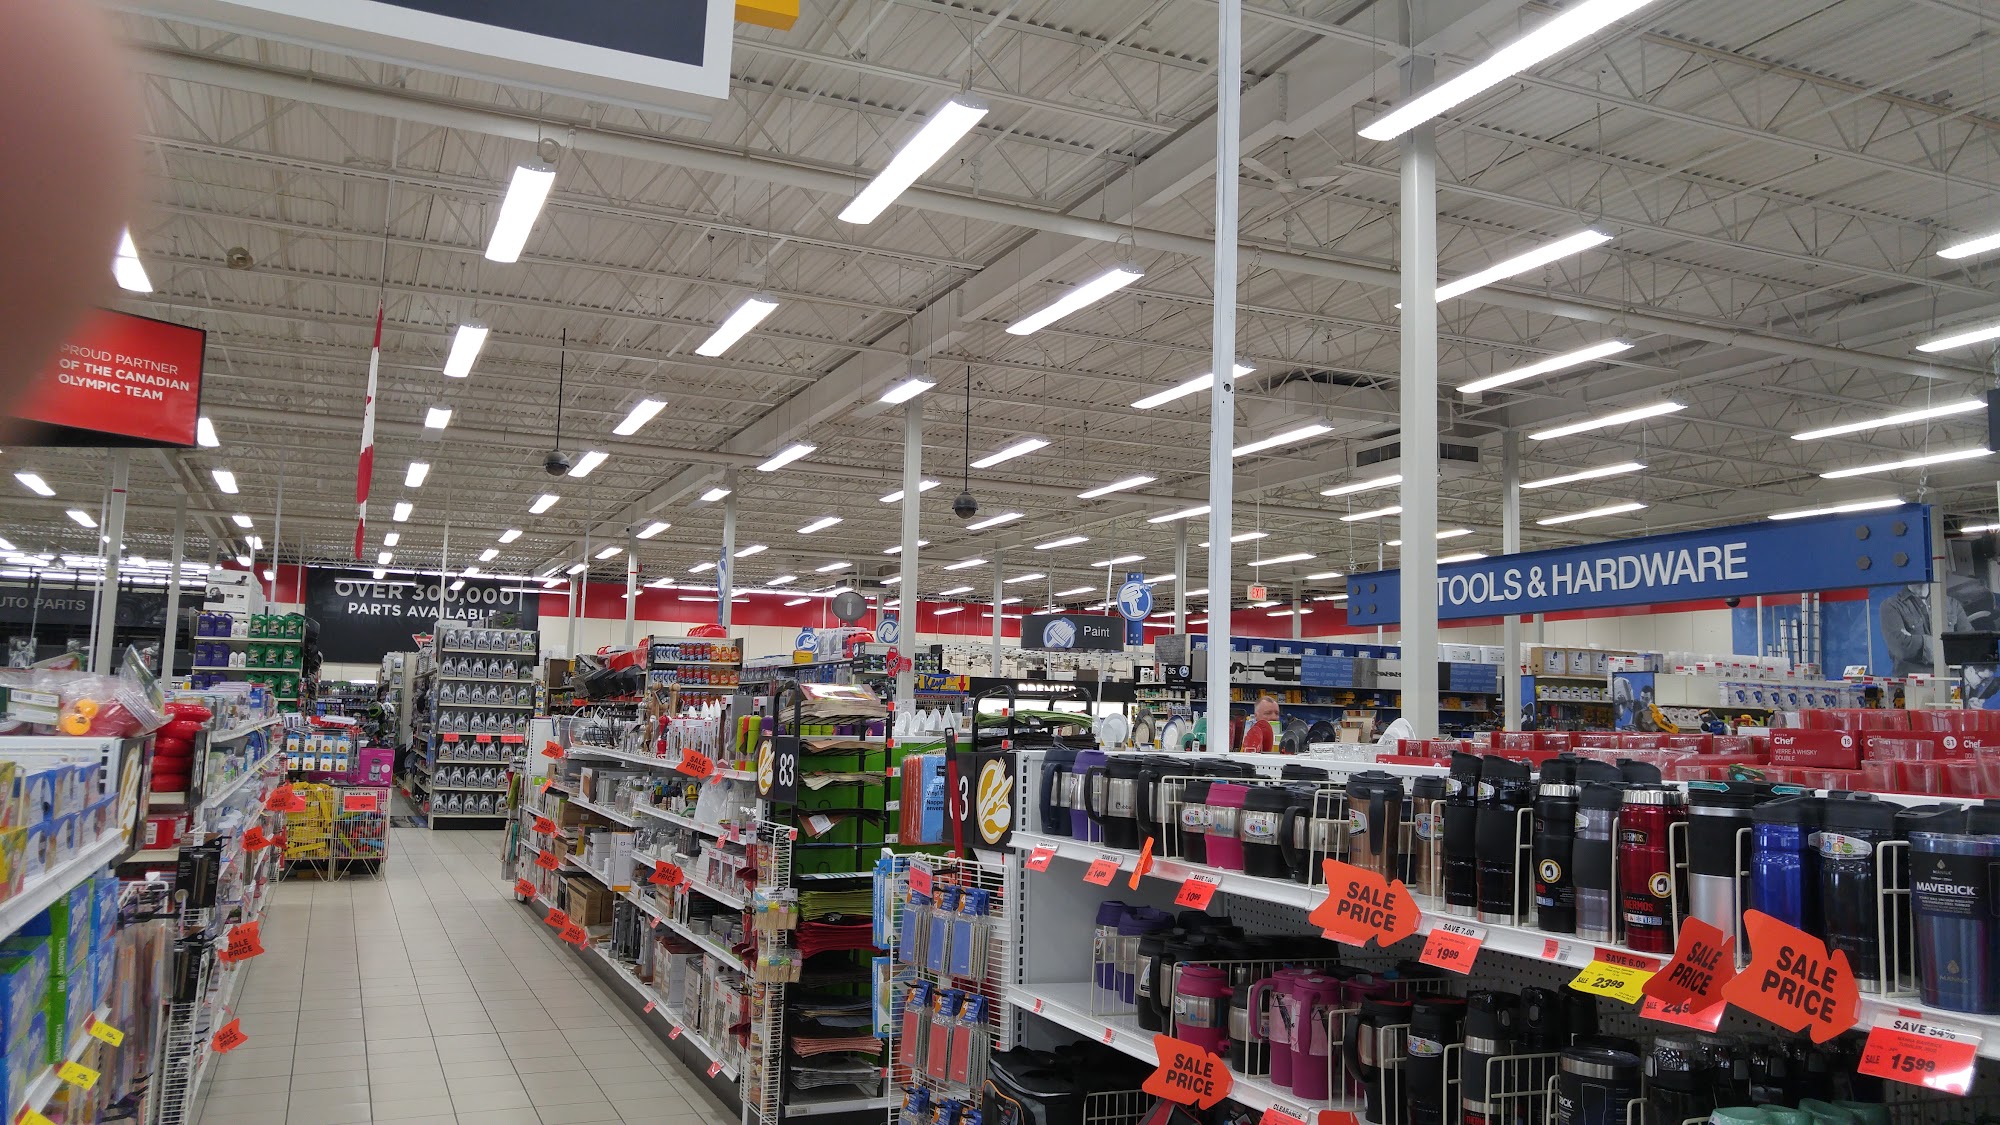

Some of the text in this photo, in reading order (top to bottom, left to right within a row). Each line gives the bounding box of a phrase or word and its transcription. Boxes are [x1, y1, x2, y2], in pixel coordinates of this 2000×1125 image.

[60, 343, 178, 375] PROUD PARTNER
[59, 358, 190, 391] OF THE CANADIAN
[58, 373, 163, 401] OLYMPIC TEAM
[1437, 542, 1748, 606] TOOLS & HARDWARE
[335, 583, 514, 605] OVER 300,000
[1251, 588, 1265, 599] EXIT
[0, 596, 86, 611] UTO PARTS
[348, 602, 497, 620] PARTS AVALABL
[1083, 625, 1110, 638] Paint
[1167, 667, 1176, 675] 35
[1774, 736, 1794, 745] Chef
[1963, 740, 1980, 748] Chef
[1792, 747, 1797, 755] À
[686, 762, 706, 774] PRICE
[690, 756, 707, 766] SALE
[779, 753, 795, 787] 83
[949, 775, 969, 821] 3
[656, 873, 676, 882] PRICE
[661, 867, 678, 876] SALE
[1347, 881, 1397, 911] SALE
[1916, 881, 1976, 896] MAVERICK
[1336, 899, 1397, 932] PRICE
[1442, 923, 1475, 936] SAVE 7.00
[228, 939, 249, 951] SALE
[228, 945, 253, 959] PRICE
[57, 937, 66, 975] SANDWICH
[1437, 947, 1460, 960] 1999
[1605, 953, 1646, 969] SAVE 6.00
[1687, 941, 1723, 972] SALE
[1776, 945, 1838, 994] SALE
[57, 980, 65, 993] 180
[1591, 977, 1625, 989] 2399
[1668, 962, 1713, 997] PRICE
[1761, 970, 1836, 1024] PRICE
[1662, 1001, 1690, 1015] 249
[219, 1028, 234, 1041] SALE
[1893, 1020, 1956, 1040] SAVE 54%
[54, 1023, 63, 1061] SANDWICH
[220, 1034, 238, 1049] PRICE
[1173, 1053, 1214, 1078] SALE
[1865, 1054, 1880, 1064] SALE
[1892, 1053, 1936, 1073] 1599
[1165, 1070, 1215, 1097] PRICE
[1273, 1103, 1302, 1120] CLEARANCE
